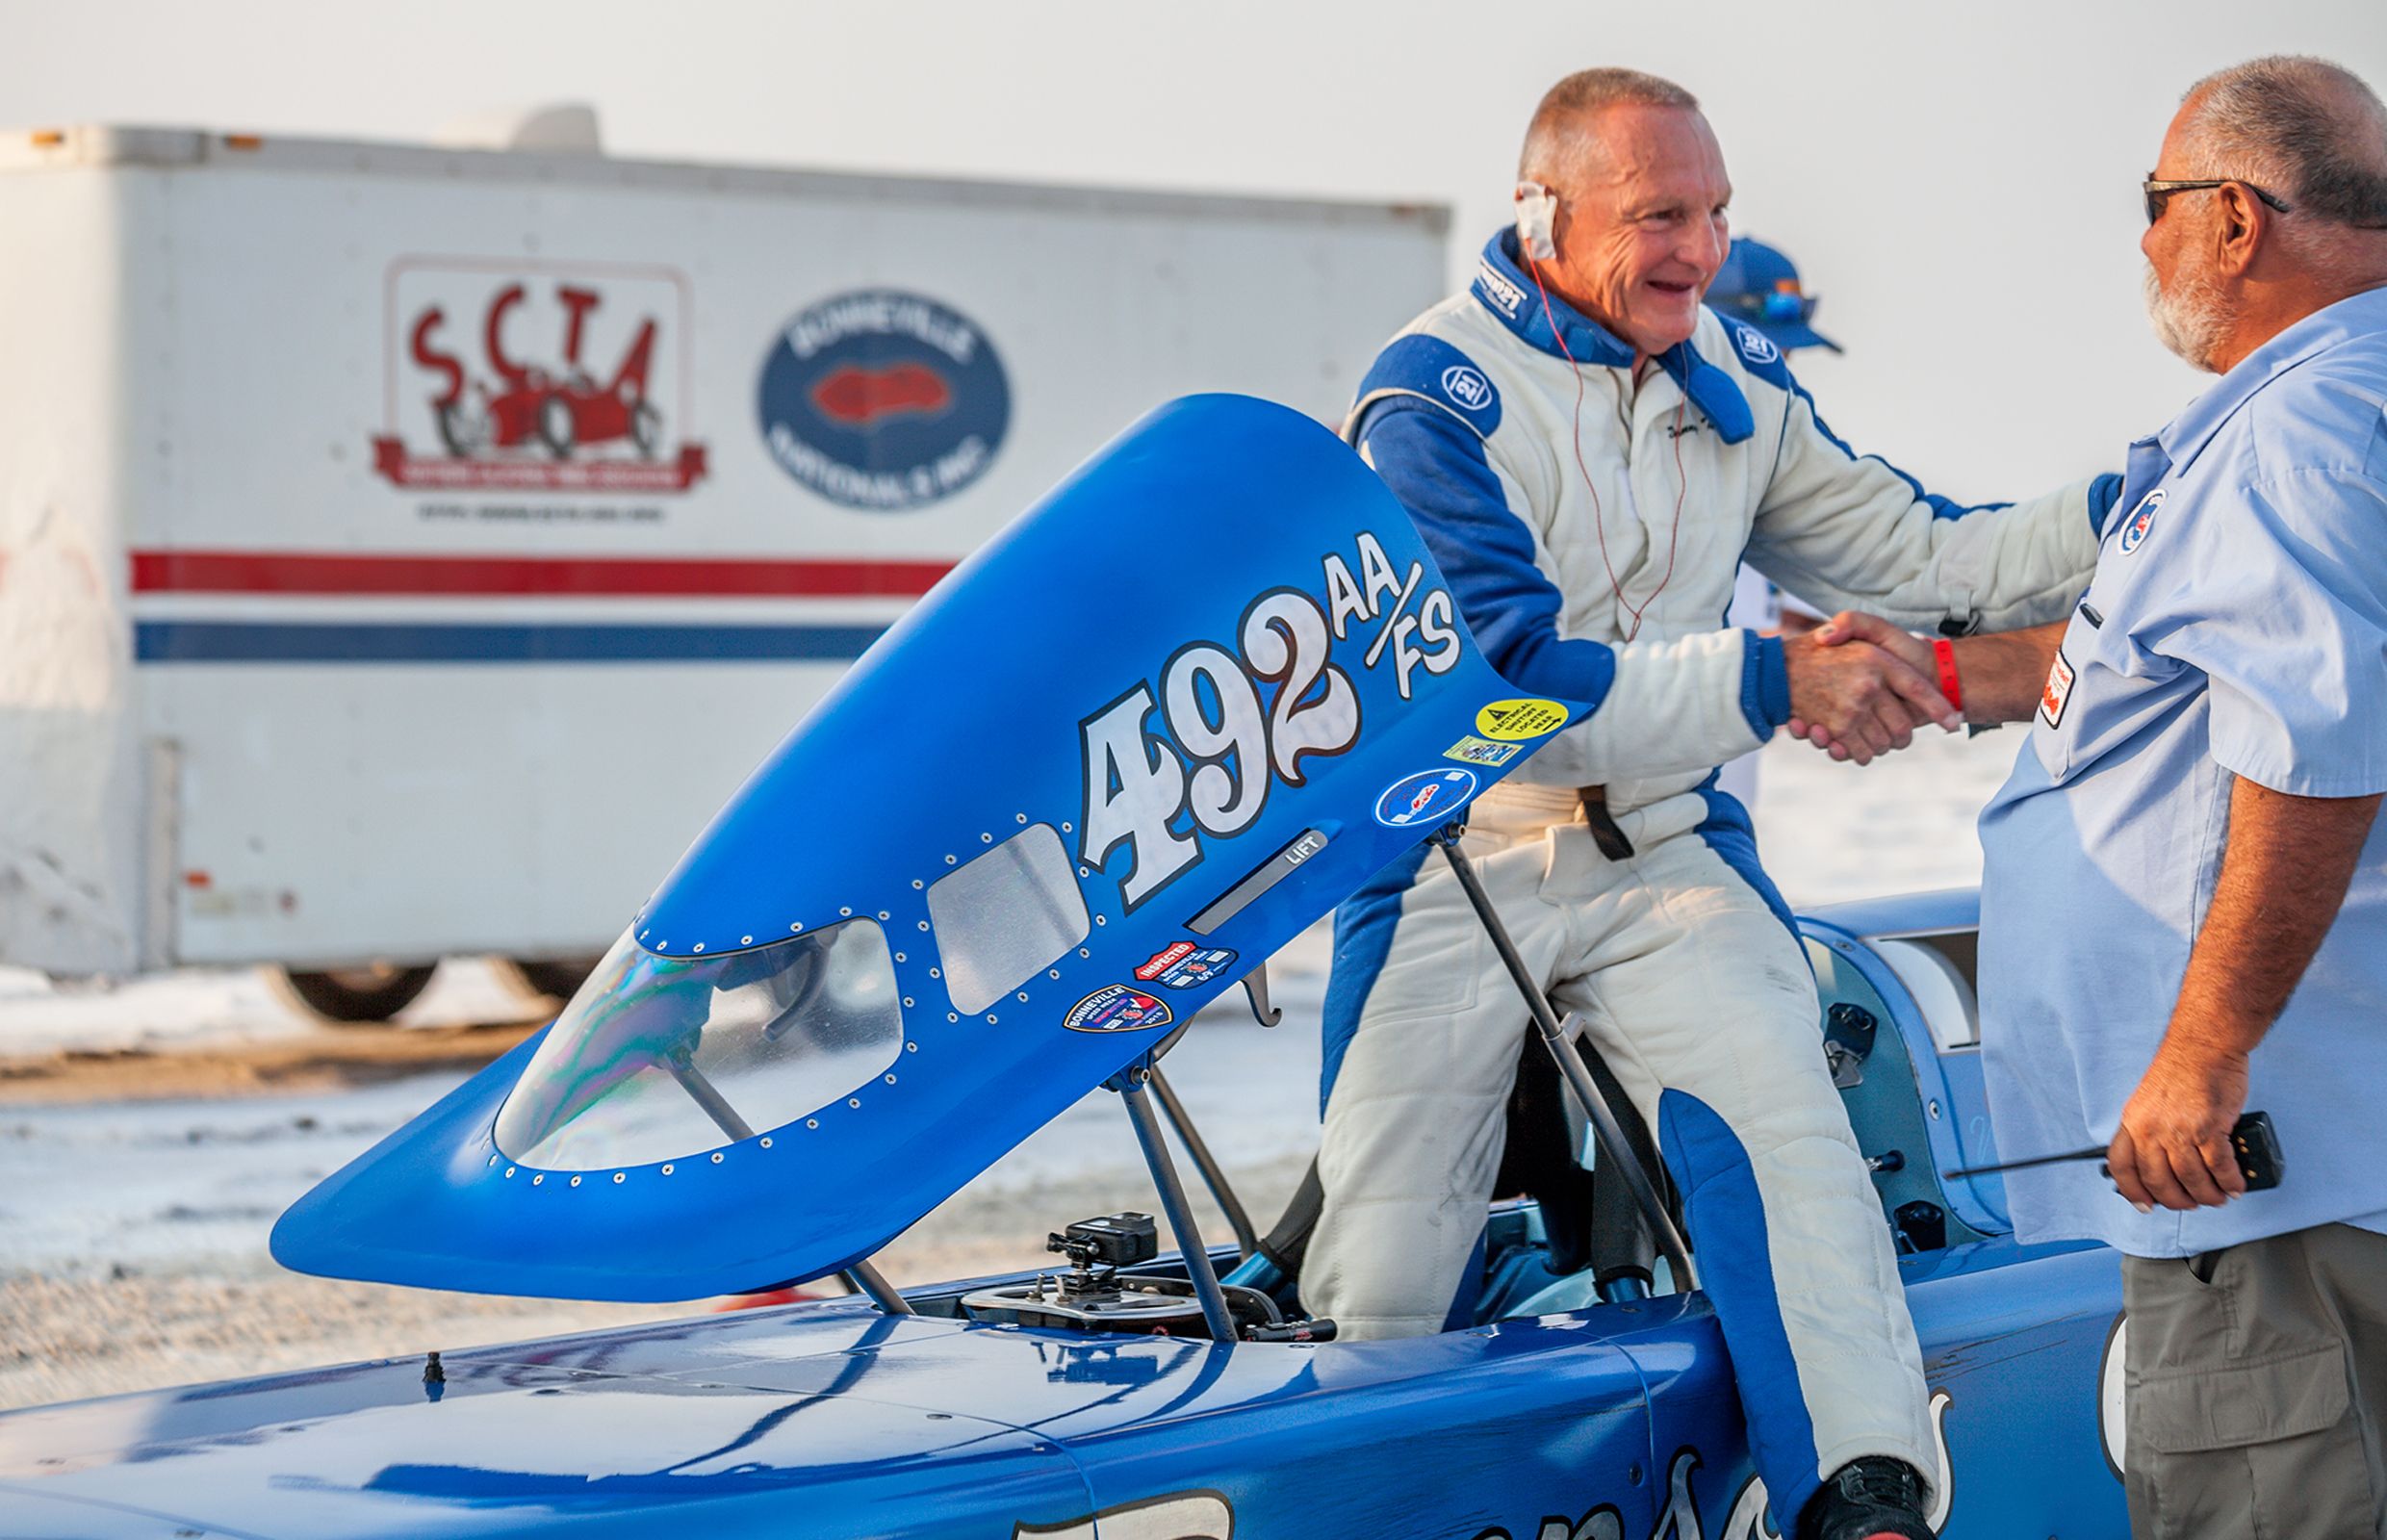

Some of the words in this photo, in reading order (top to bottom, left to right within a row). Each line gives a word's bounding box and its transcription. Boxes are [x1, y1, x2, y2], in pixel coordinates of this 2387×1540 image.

[411, 285, 656, 404] SCTA
[1488, 703, 1533, 733] ELECTRICAL
[1515, 709, 1550, 733] LOCATED
[1078, 585, 1362, 916] 492
[1284, 835, 1320, 865] LIFT
[1139, 943, 1192, 978] INSPECTED
[1067, 986, 1126, 1027] BONNEVILLE
